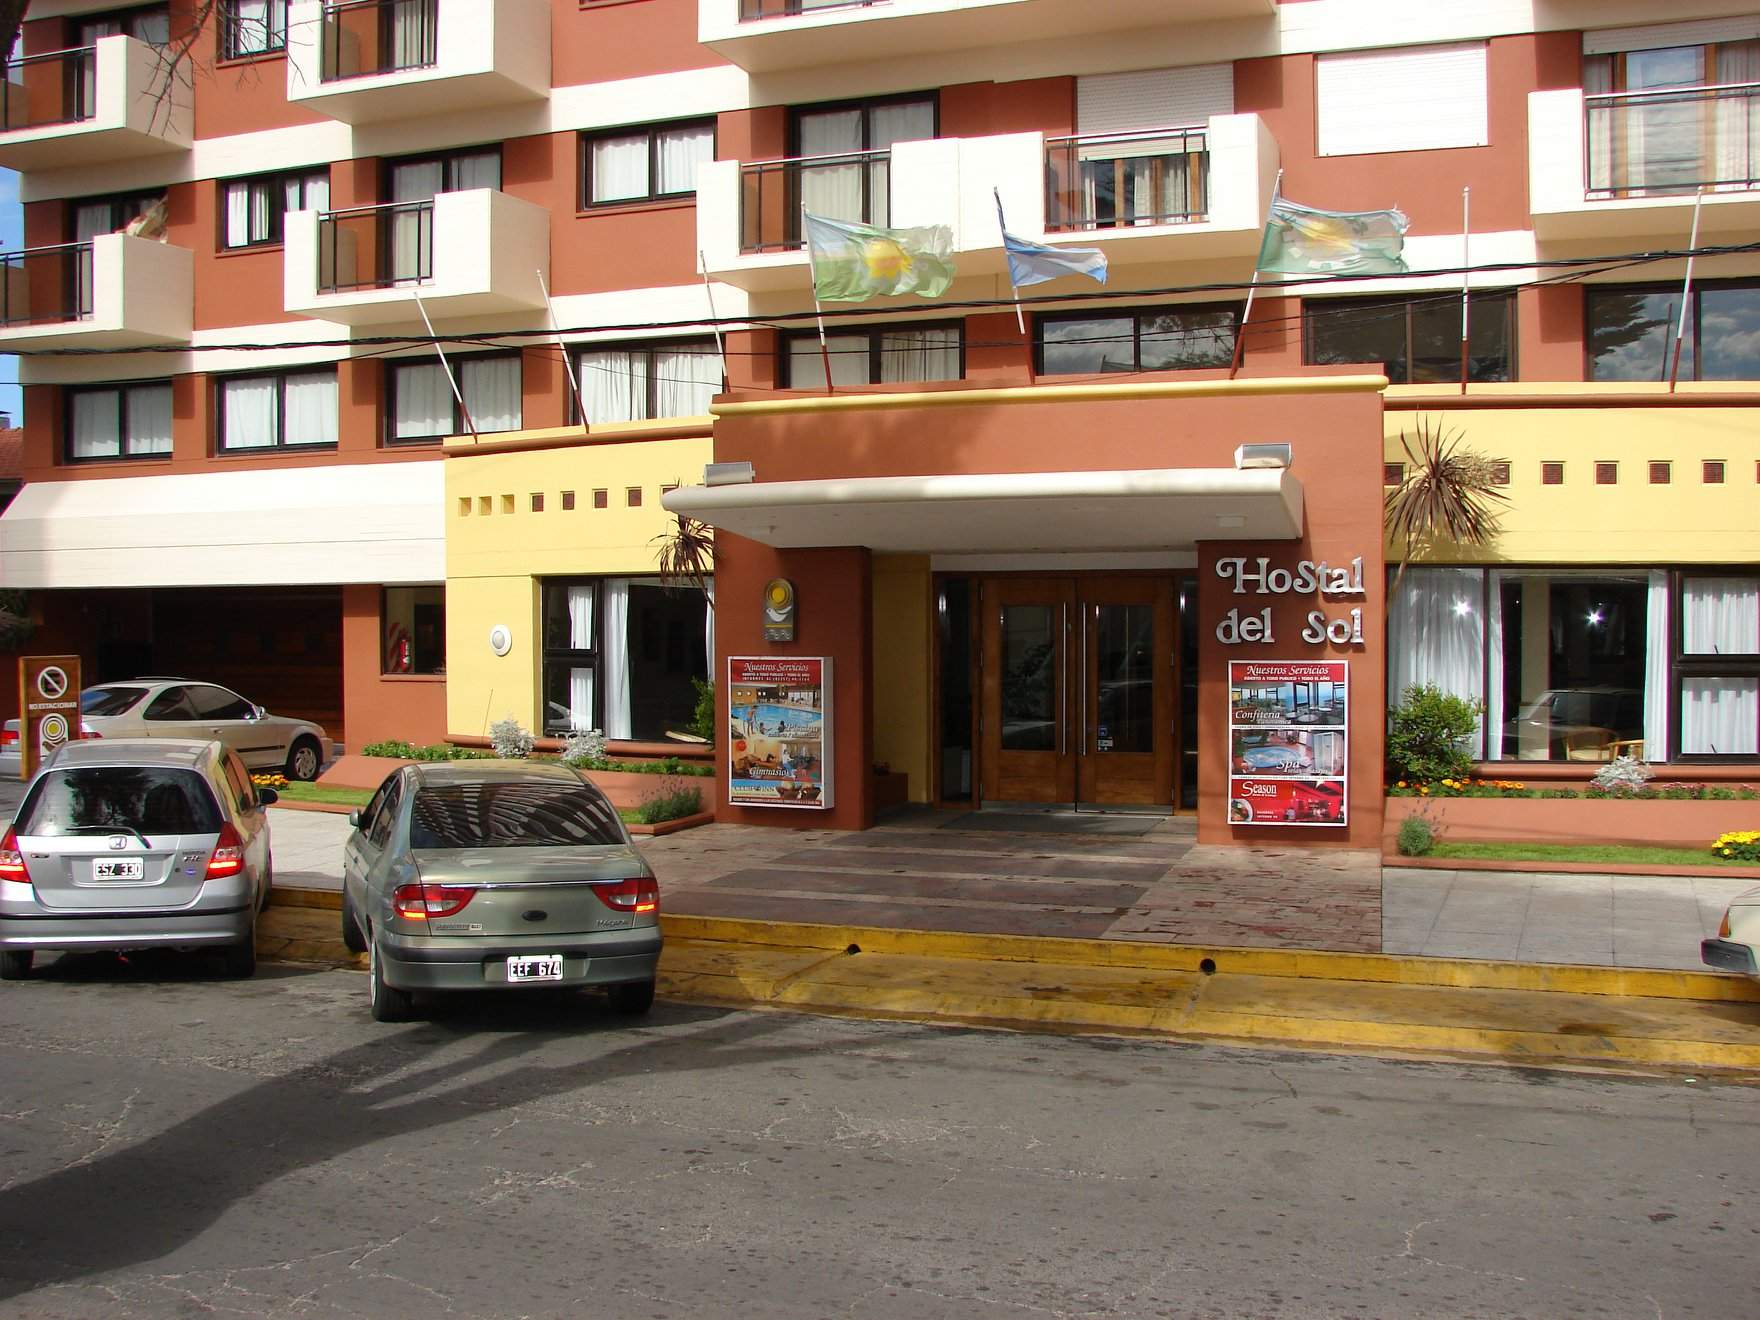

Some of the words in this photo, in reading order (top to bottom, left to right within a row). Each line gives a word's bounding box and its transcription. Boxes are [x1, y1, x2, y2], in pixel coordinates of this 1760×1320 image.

[1216, 607, 1275, 644] del
[1301, 607, 1365, 644] Sol
[744, 661, 776, 673] Nuestros
[776, 662, 809, 672] Servicios
[1246, 664, 1287, 676] Nuestros
[1288, 664, 1329, 676] Servicios
[1276, 760, 1301, 773] Spa
[1241, 781, 1277, 797] Season
[510, 962, 531, 977] EEF
[538, 961, 561, 976] 674
